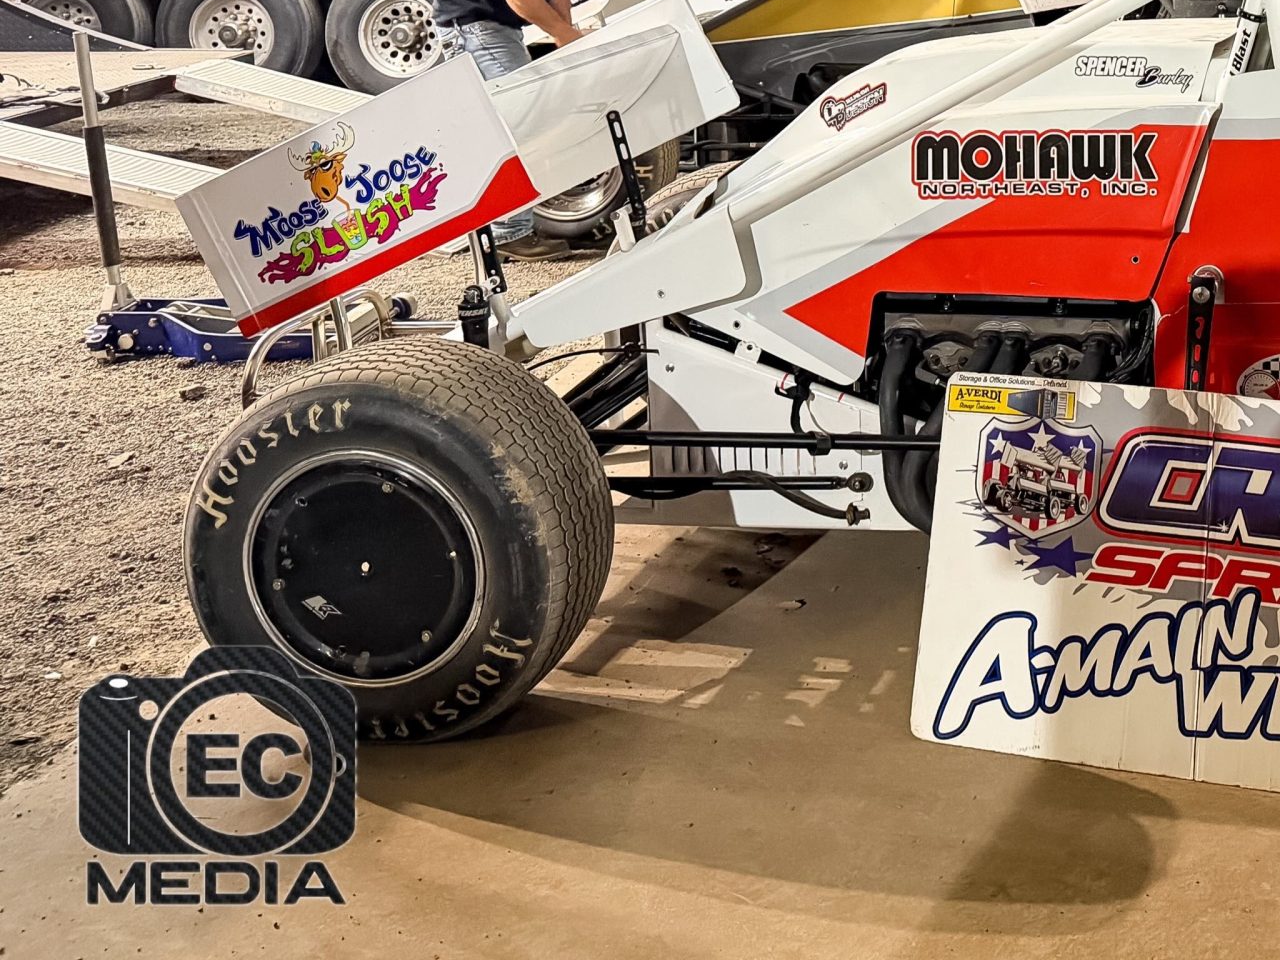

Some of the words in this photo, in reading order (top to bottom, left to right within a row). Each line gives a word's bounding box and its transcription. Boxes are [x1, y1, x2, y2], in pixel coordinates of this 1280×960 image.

[1231, 27, 1252, 73] Blast
[1075, 55, 1148, 77] SPENCER
[1136, 66, 1194, 93] Burley
[914, 133, 1159, 183] MOHAWK
[921, 181, 1090, 199] NORTHEAST,
[1101, 181, 1159, 197] INC.
[290, 183, 416, 274] SLUSH
[955, 387, 1003, 403] A-VERDI
[958, 374, 982, 384] Storage
[989, 377, 1007, 385] Office
[195, 396, 354, 529] Hoosier
